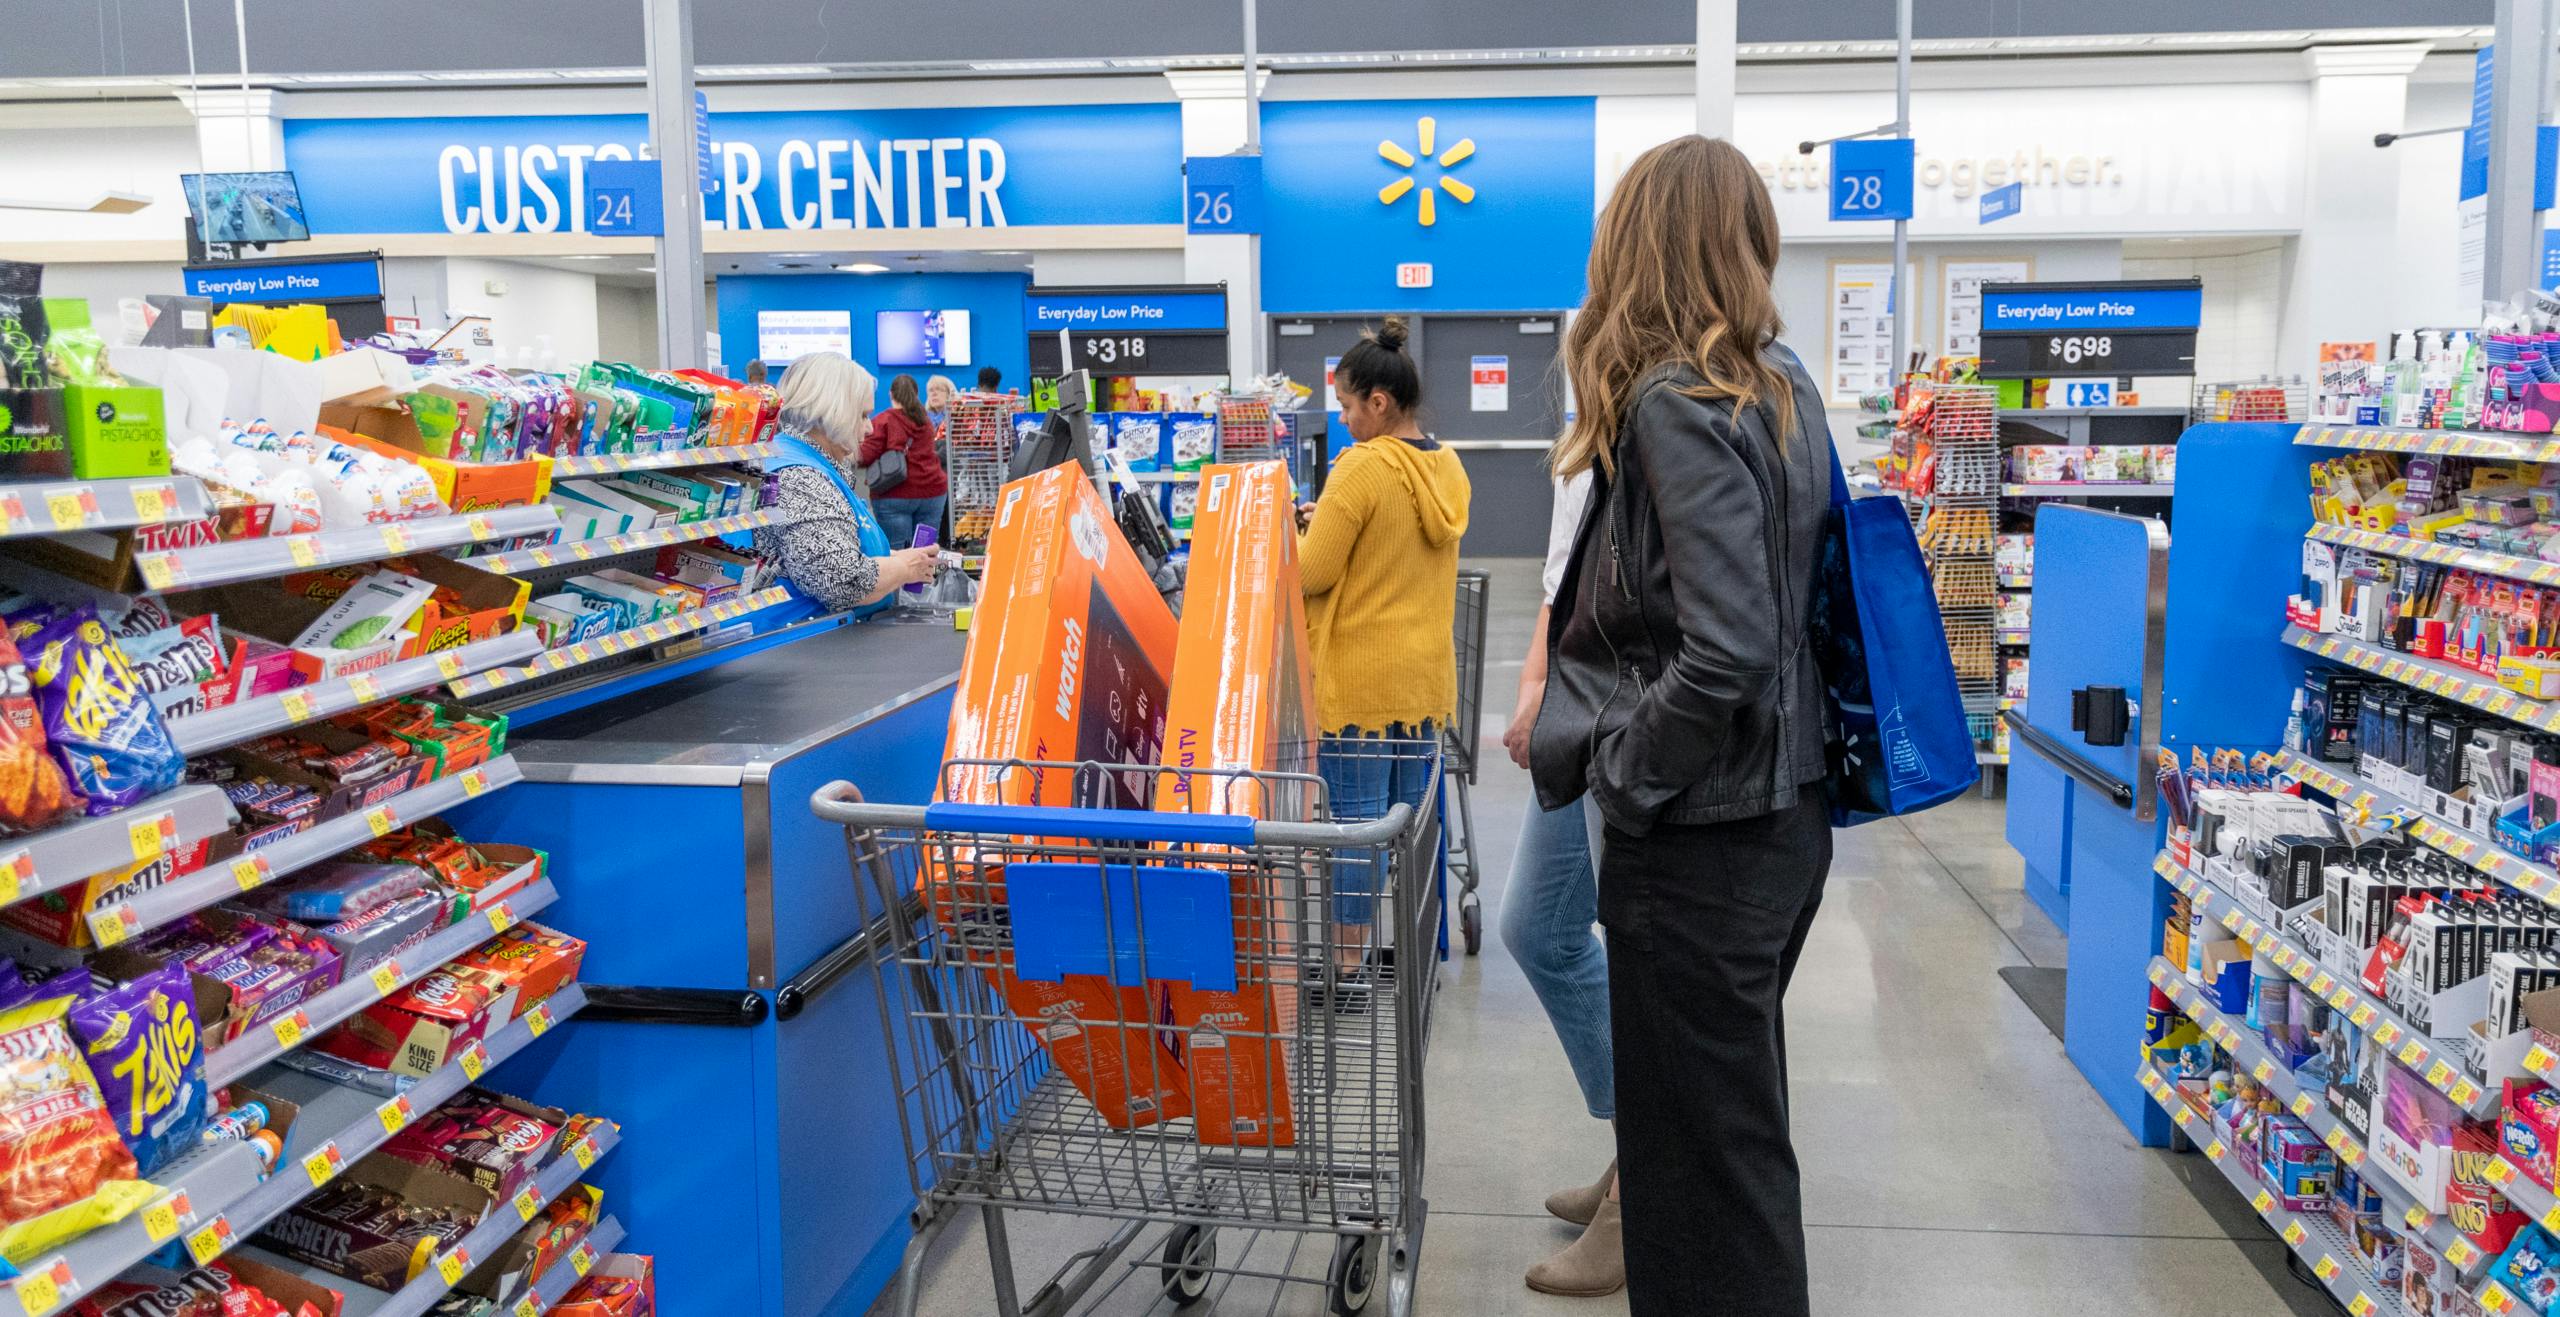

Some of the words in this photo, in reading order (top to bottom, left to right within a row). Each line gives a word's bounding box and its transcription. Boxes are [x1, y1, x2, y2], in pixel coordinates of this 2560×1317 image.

[1914, 144, 2123, 199] ogether.
[438, 142, 762, 234] CUSTER
[778, 137, 1008, 230] CENTER
[1841, 175, 1883, 211] 28
[595, 194, 634, 227] 24
[1193, 190, 1233, 225] 26
[197, 279, 257, 295] Everyday
[259, 277, 285, 290] Low
[287, 275, 320, 289] Price
[1403, 265, 1428, 286] EXIT
[1037, 305, 1099, 322] Everyday
[1101, 305, 1129, 319] Low
[1131, 305, 1164, 318] Price
[1997, 303, 2063, 321] Everyday
[2066, 303, 2096, 317] Low
[2099, 302, 2135, 316] Price
[99, 427, 164, 443] PISTACHIOS
[638, 474, 651, 488] ICE
[652, 479, 692, 500] BREAKERS
[136, 515, 222, 552] TWIX
[302, 622, 334, 649] IMPLY
[333, 600, 357, 619] GUM
[1055, 616, 1083, 722] watch
[1179, 728, 1198, 750] TV
[363, 770, 411, 806] PAYDAY
[95, 853, 172, 909] m&m's
[259, 984, 304, 1018] SNICKERS
[1038, 998, 1085, 1017] onn.
[1208, 1001, 1239, 1011] 720p
[1200, 1010, 1250, 1023] onn.
[408, 1042, 436, 1062] KING
[407, 1055, 433, 1074] SIZE
[2345, 1096, 2368, 1119] STAR
[2344, 1107, 2369, 1136] WARS
[474, 1167, 497, 1182] KING
[2449, 1201, 2487, 1234] UNO
[264, 1211, 353, 1263] ERSHEY'S
[225, 1290, 251, 1306] SHARE
[231, 1303, 248, 1315] SIZE
